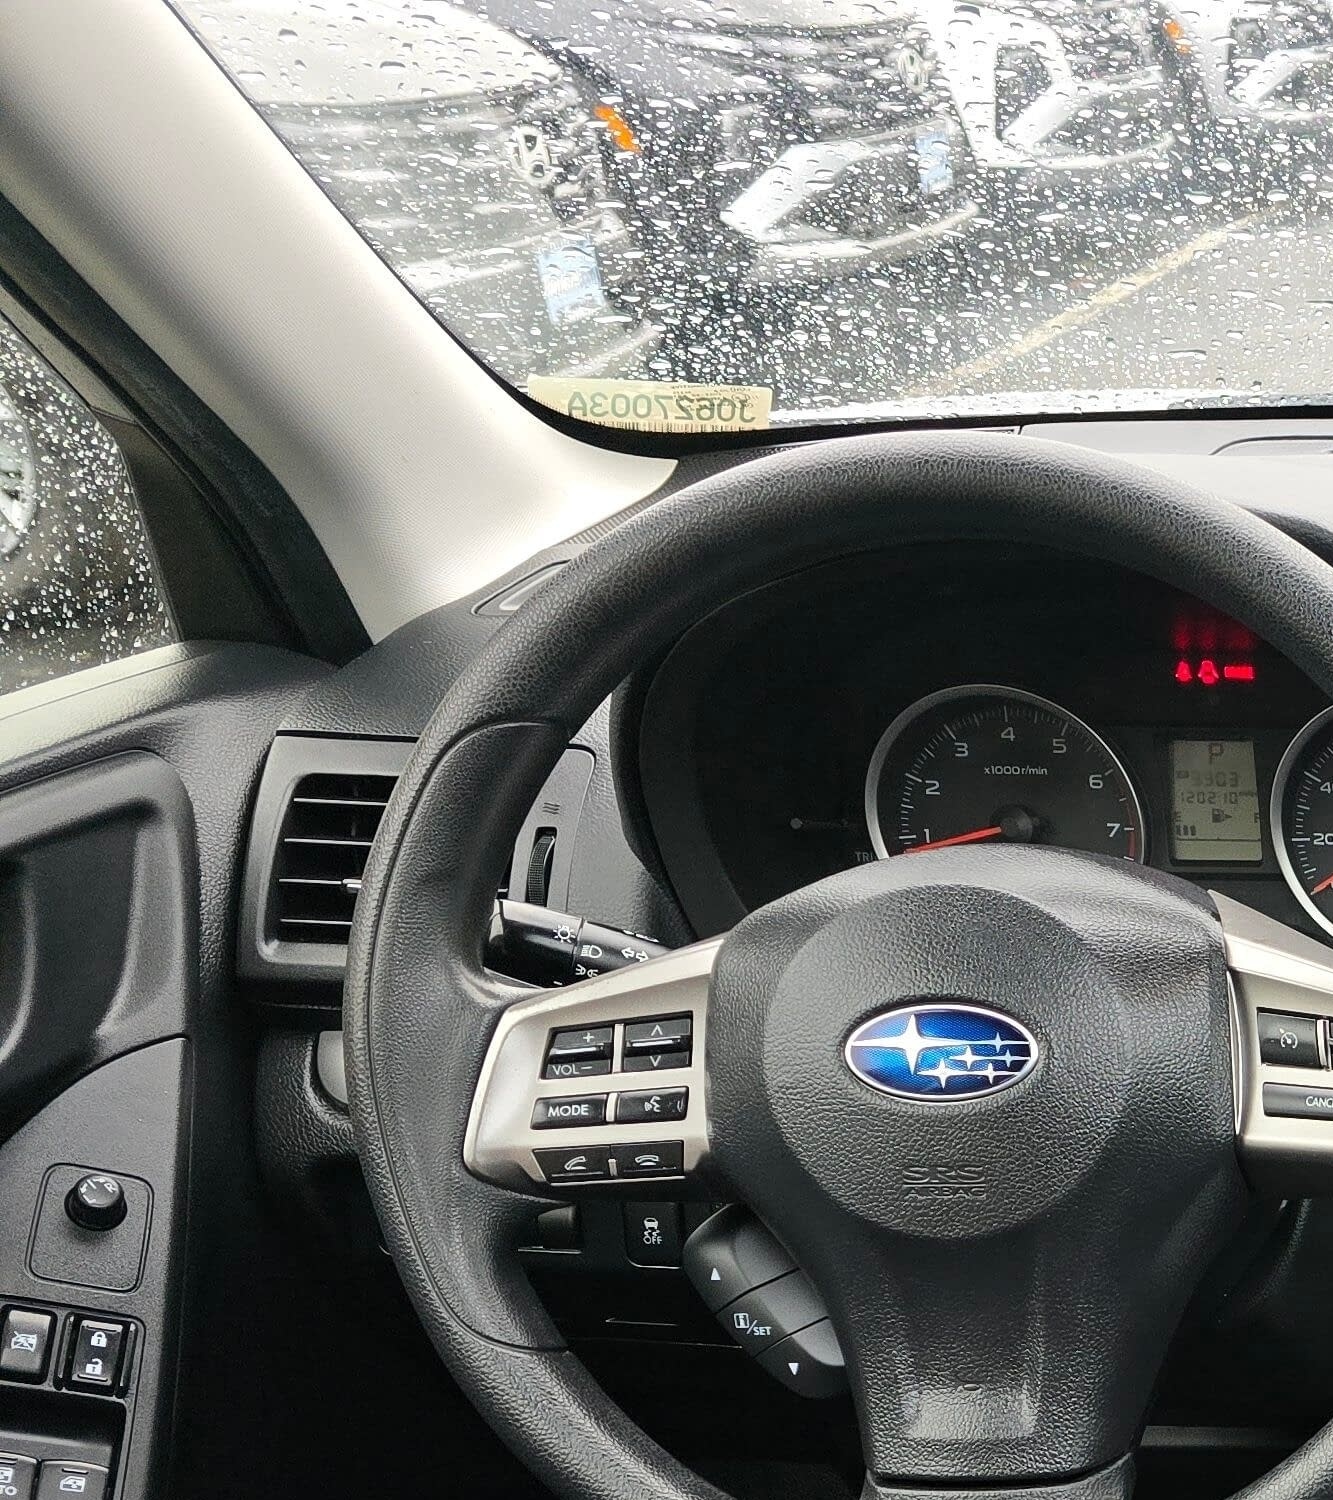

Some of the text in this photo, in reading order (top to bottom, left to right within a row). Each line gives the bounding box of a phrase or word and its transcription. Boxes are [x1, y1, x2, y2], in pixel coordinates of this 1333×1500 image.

[1000, 727, 1016, 742] 4
[954, 742, 969, 757] 3
[1052, 738, 1067, 754] 5
[1209, 743, 1224, 765] P
[925, 780, 941, 795] 2
[1089, 774, 1104, 789] 6
[923, 829, 930, 844] 1
[1106, 823, 1121, 838] 7
[855, 851, 874, 863] TRI
[552, 1064, 580, 1076] VOL
[547, 1104, 590, 1118] MODE
[903, 1166, 986, 1183] SRS
[643, 1236, 663, 1245] OFF
